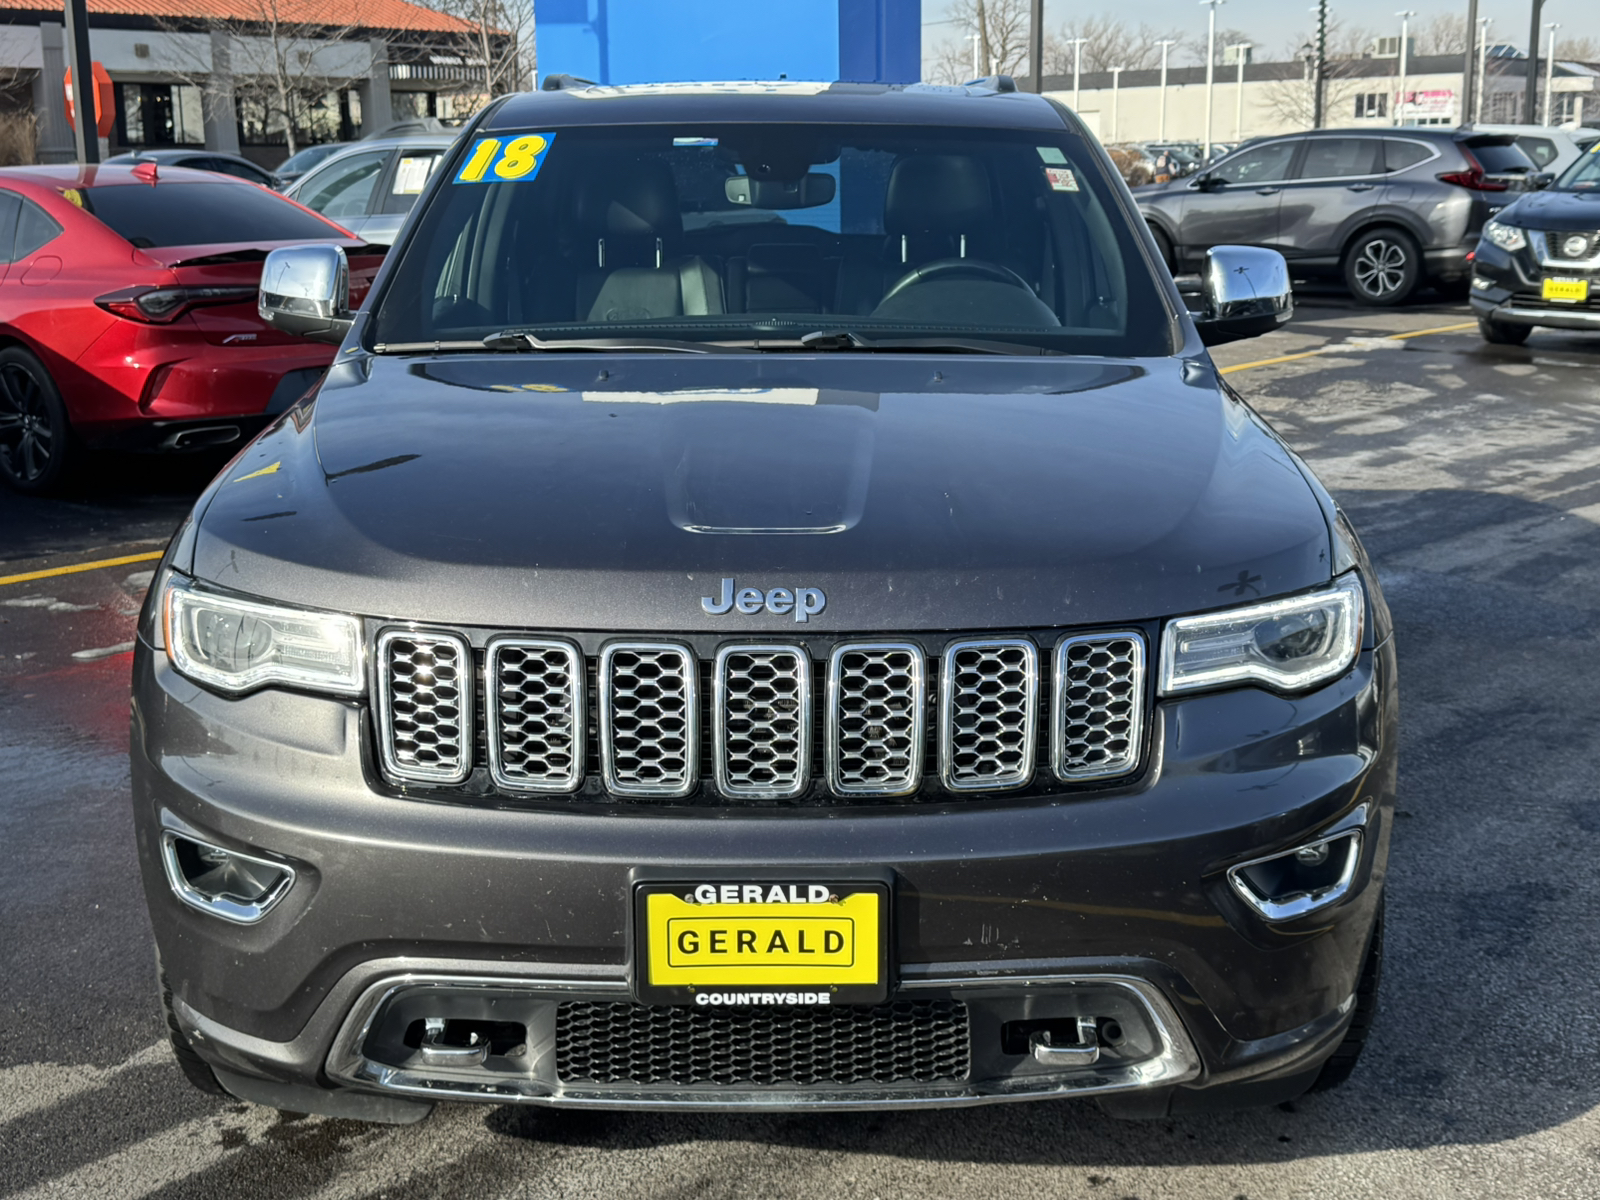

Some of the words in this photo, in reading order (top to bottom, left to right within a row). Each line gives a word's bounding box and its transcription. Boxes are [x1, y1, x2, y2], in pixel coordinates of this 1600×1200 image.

[459, 135, 547, 182] 18
[701, 578, 826, 623] Jeep
[694, 884, 830, 904] GERALD
[677, 929, 845, 954] GERALD
[695, 992, 831, 1006] COUNTRYSIDE
